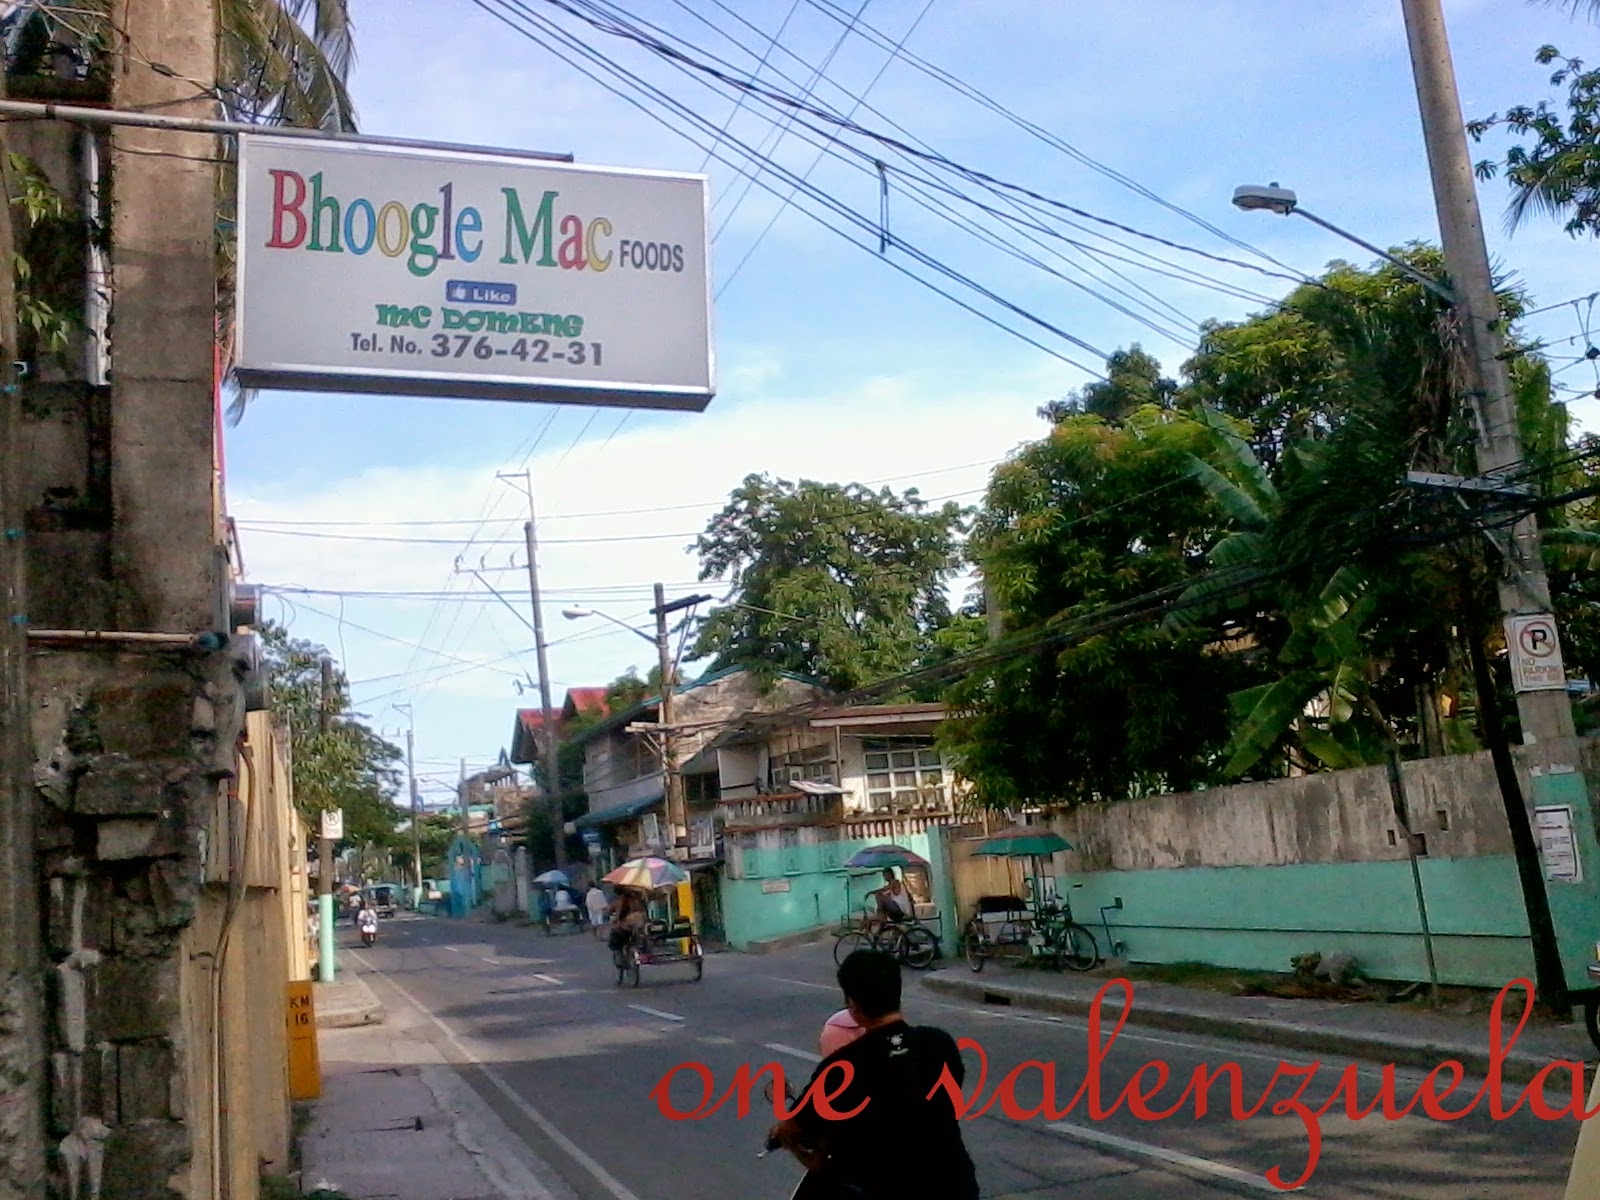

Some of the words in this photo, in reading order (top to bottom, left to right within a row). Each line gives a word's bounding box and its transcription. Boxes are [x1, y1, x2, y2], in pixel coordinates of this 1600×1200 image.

[265, 169, 484, 276] Bhoogle
[499, 187, 614, 272] Mac
[619, 239, 685, 273] FOODS
[473, 288, 512, 303] Like
[350, 332, 384, 353] Tel.
[390, 334, 423, 355] No.
[430, 333, 603, 367] 376-42-31
[1531, 629, 1547, 650] P
